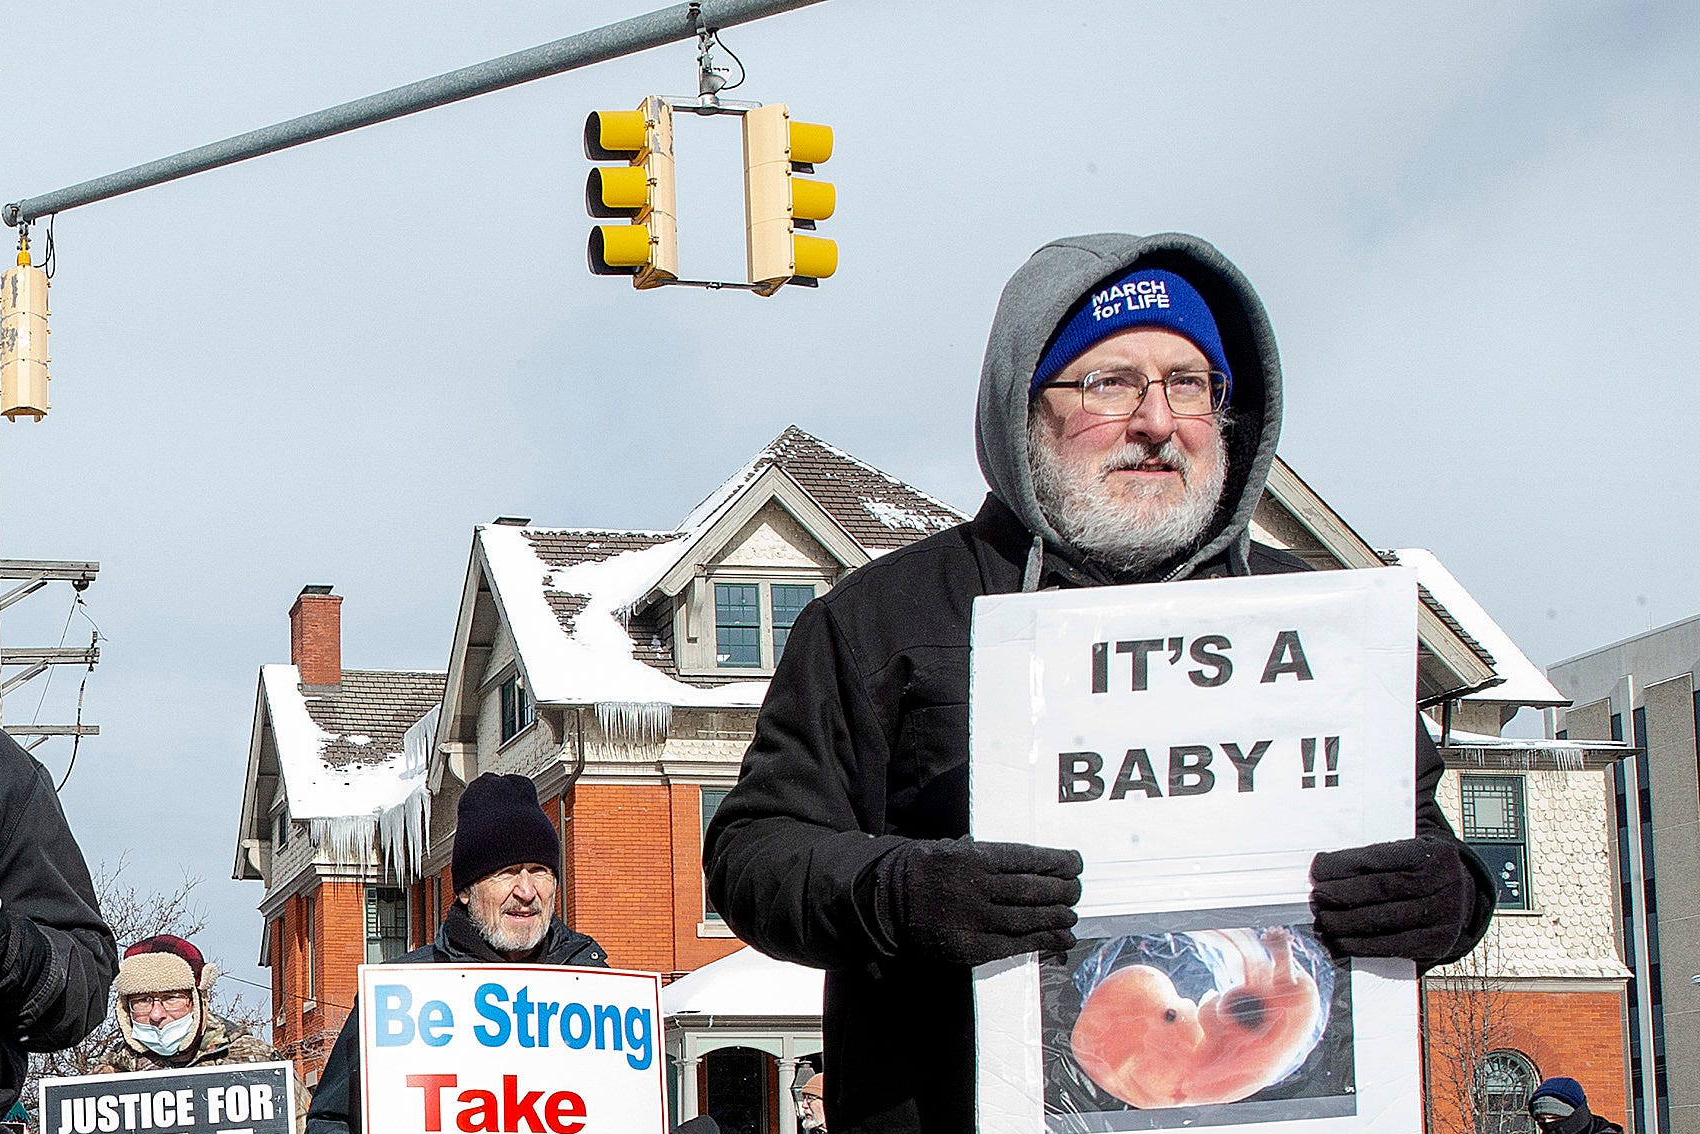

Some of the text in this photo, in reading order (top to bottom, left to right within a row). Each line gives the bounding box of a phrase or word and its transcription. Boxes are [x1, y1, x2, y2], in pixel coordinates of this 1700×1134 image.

[1092, 280, 1166, 308] MARCH
[1092, 293, 1171, 322] for LIFE
[1089, 629, 1315, 695] IT'S A
[1057, 735, 1342, 804] BABY !!
[373, 981, 653, 1071] Be Strong
[206, 1082, 276, 1125] FOR
[405, 1073, 588, 1134] Take
